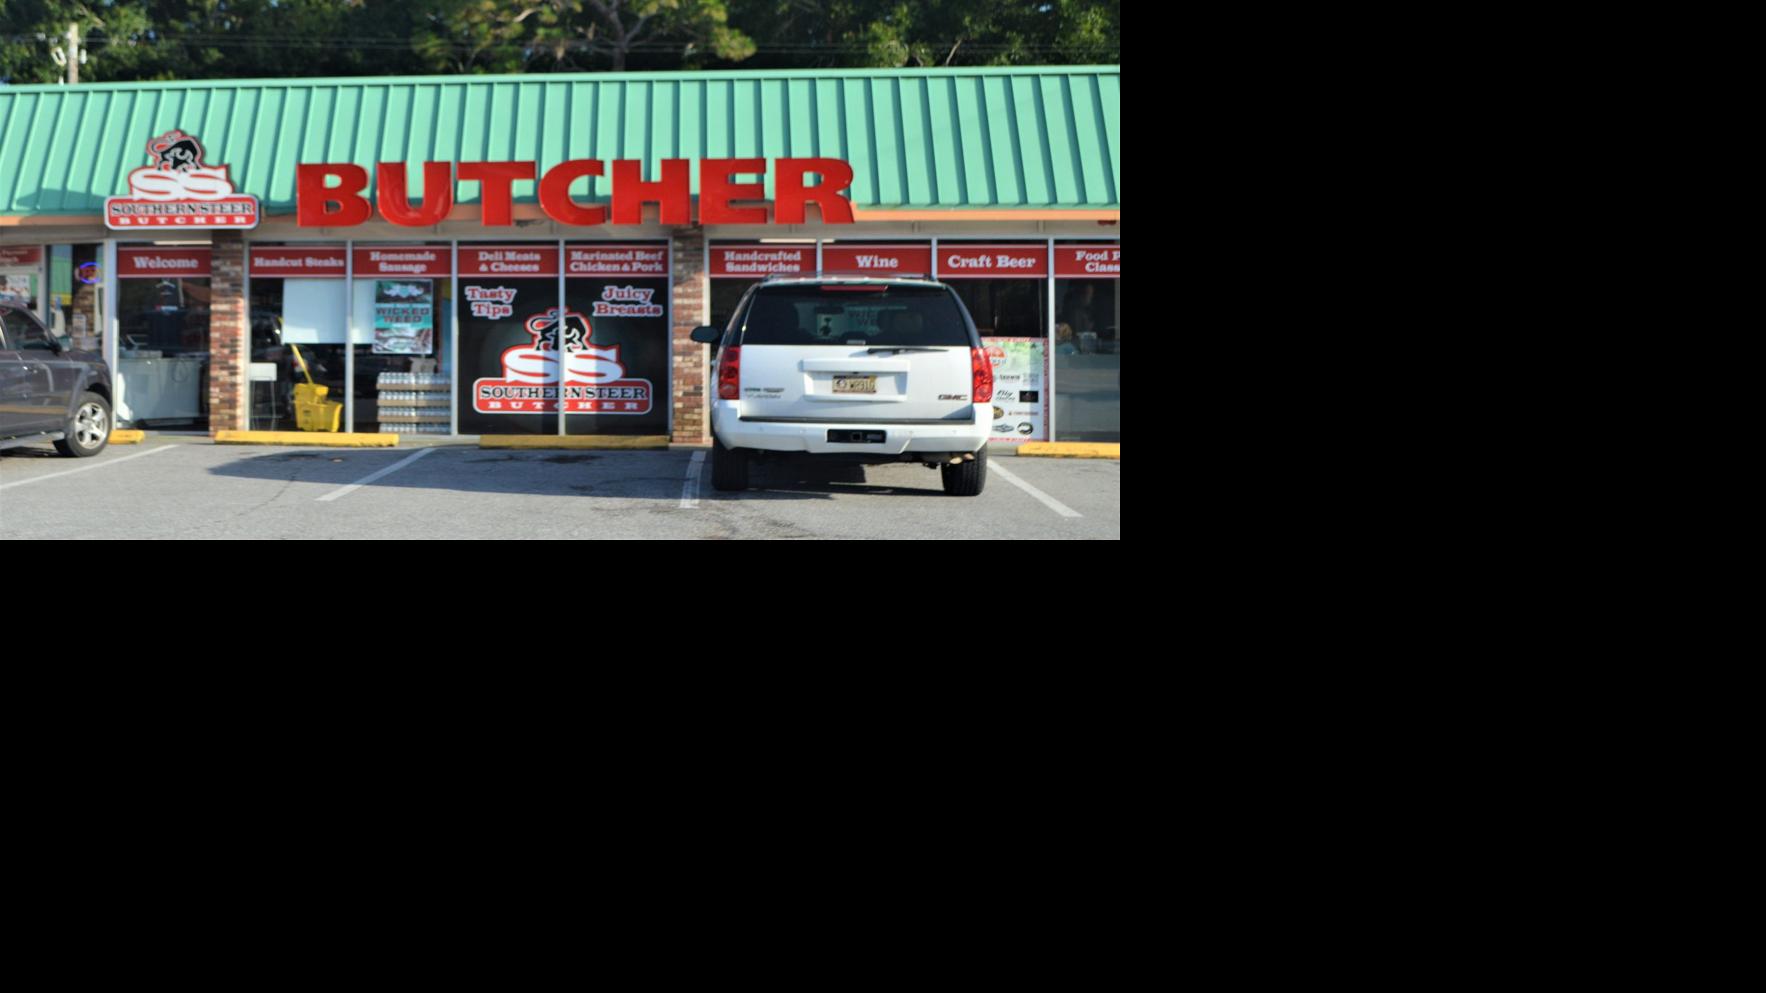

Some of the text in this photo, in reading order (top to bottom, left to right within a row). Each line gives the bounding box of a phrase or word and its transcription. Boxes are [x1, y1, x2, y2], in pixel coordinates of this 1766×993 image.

[296, 157, 857, 228] BUTCHER
[111, 203, 252, 215] SOUTHERN STEER
[119, 216, 247, 225] BUTCHER
[253, 257, 345, 267] Handcut Steaks
[369, 251, 436, 261] Homemade
[478, 251, 541, 261] Deli Meats
[570, 251, 664, 261] Marinated Beef
[724, 251, 801, 261] Handcrafted
[855, 255, 899, 268] Wine
[947, 255, 1037, 268] Craft Beer
[1075, 250, 1109, 262] Food
[133, 256, 199, 269] Welcome
[379, 262, 427, 274] Sausage
[490, 262, 540, 272] Cheeses
[569, 261, 620, 272] Chicken
[632, 261, 663, 272] Pork
[725, 262, 801, 272] Sandwiches
[465, 286, 517, 303] Tasty
[602, 286, 654, 302] Juicy
[471, 301, 513, 319] Tips
[593, 301, 664, 317] Breasts
[584, 386, 648, 400] STEER
